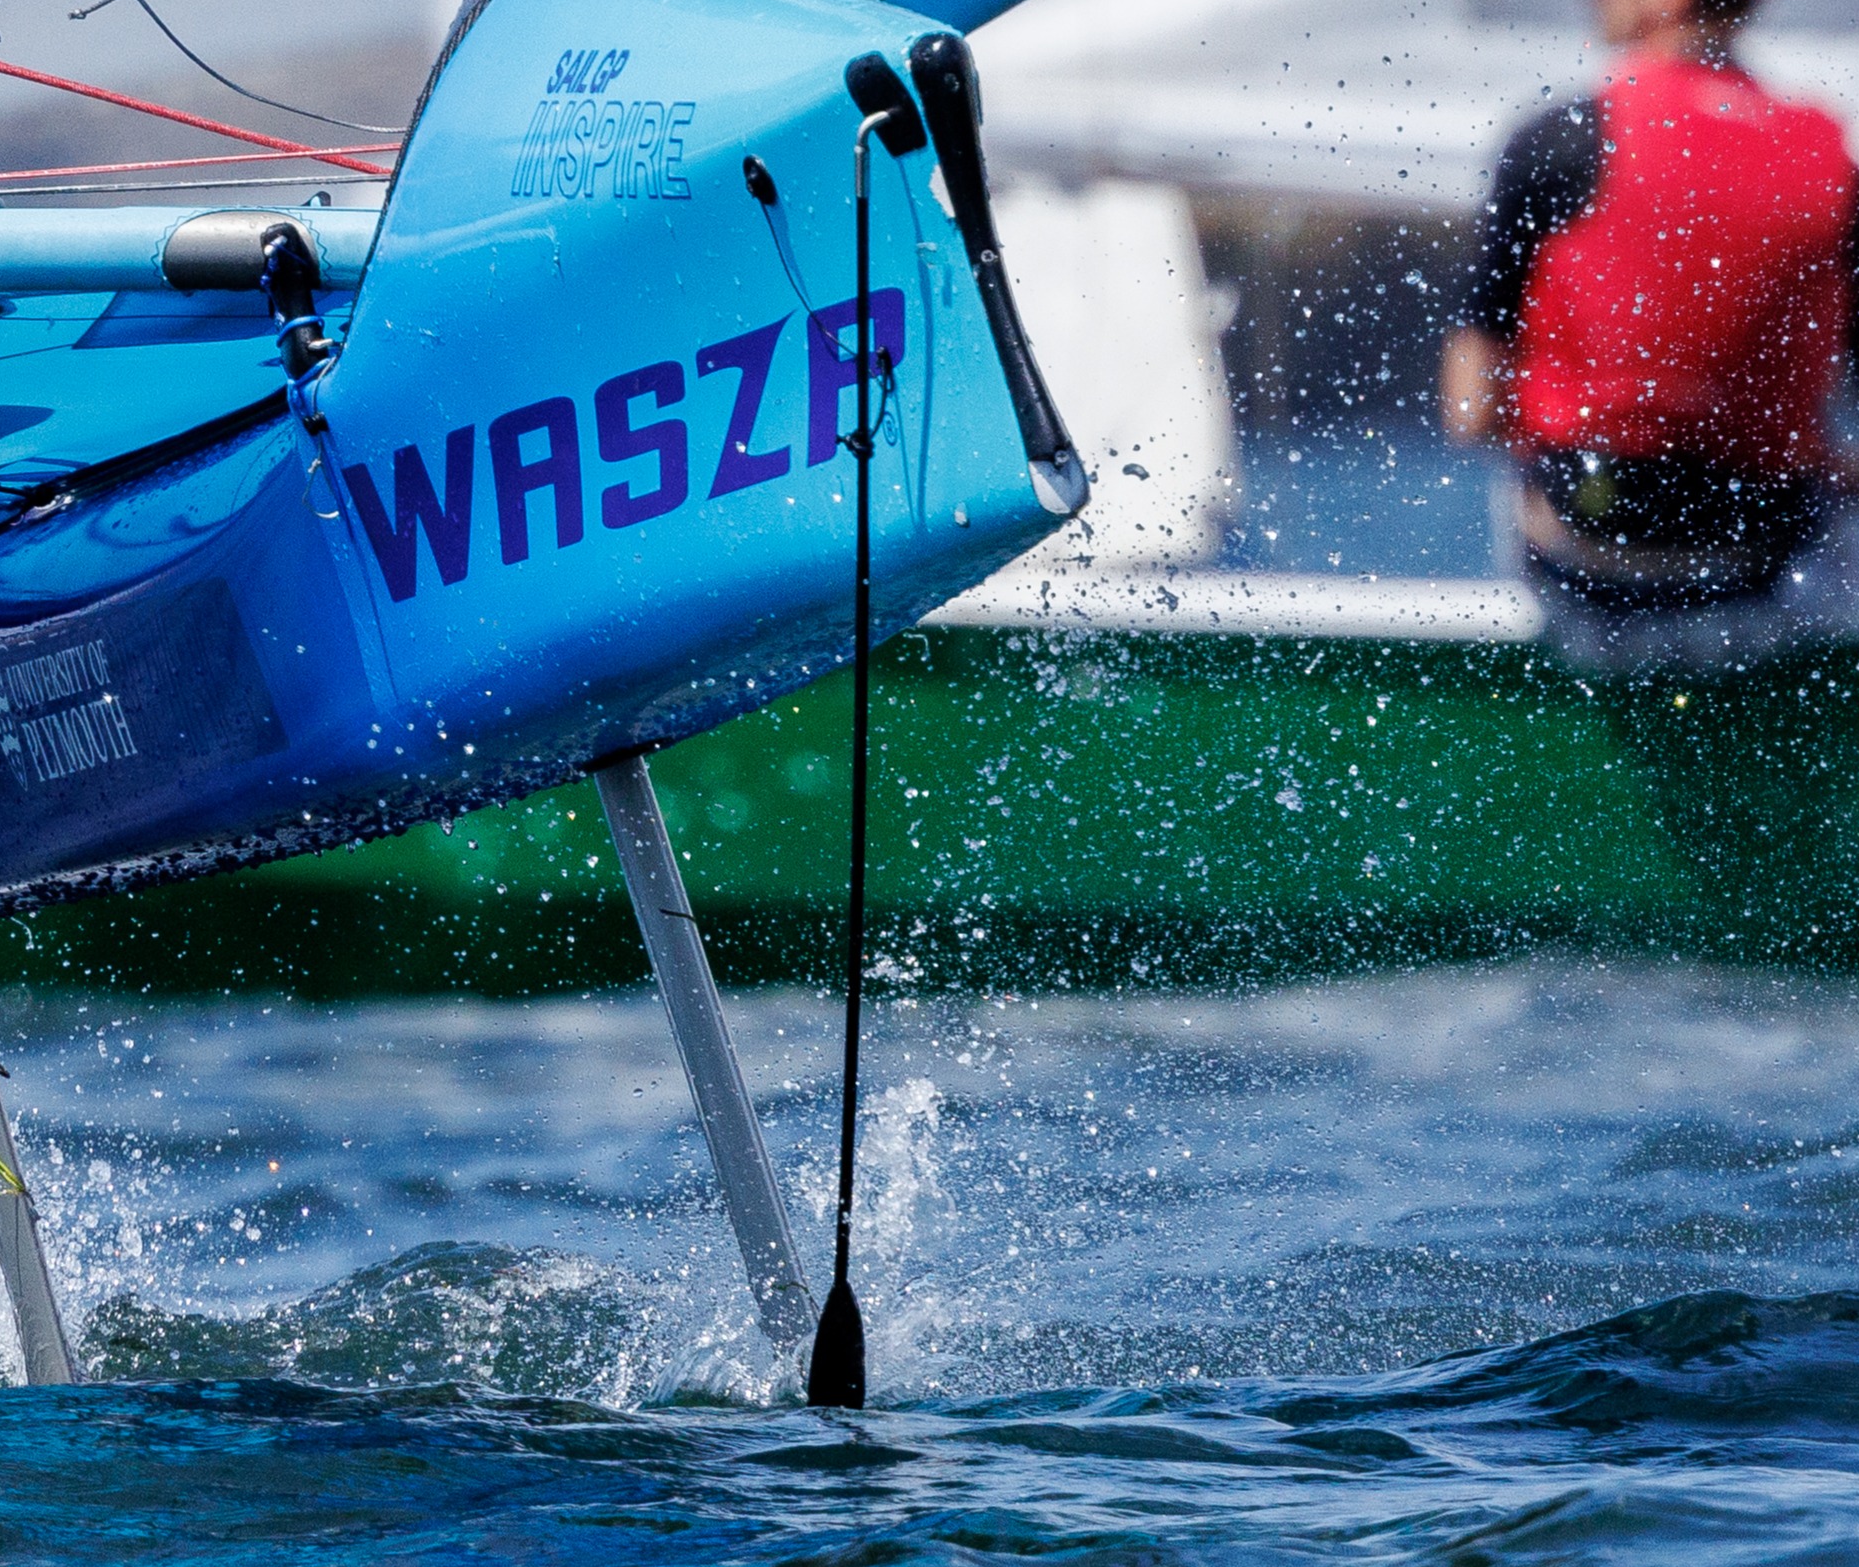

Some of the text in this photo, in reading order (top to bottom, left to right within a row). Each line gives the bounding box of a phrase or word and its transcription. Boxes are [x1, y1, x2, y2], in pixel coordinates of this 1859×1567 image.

[510, 99, 697, 200] INSPIRE
[341, 287, 906, 604] WASZP
[5, 638, 112, 710] UNIVERSITY OF
[21, 694, 139, 782] PLYMOUTH
